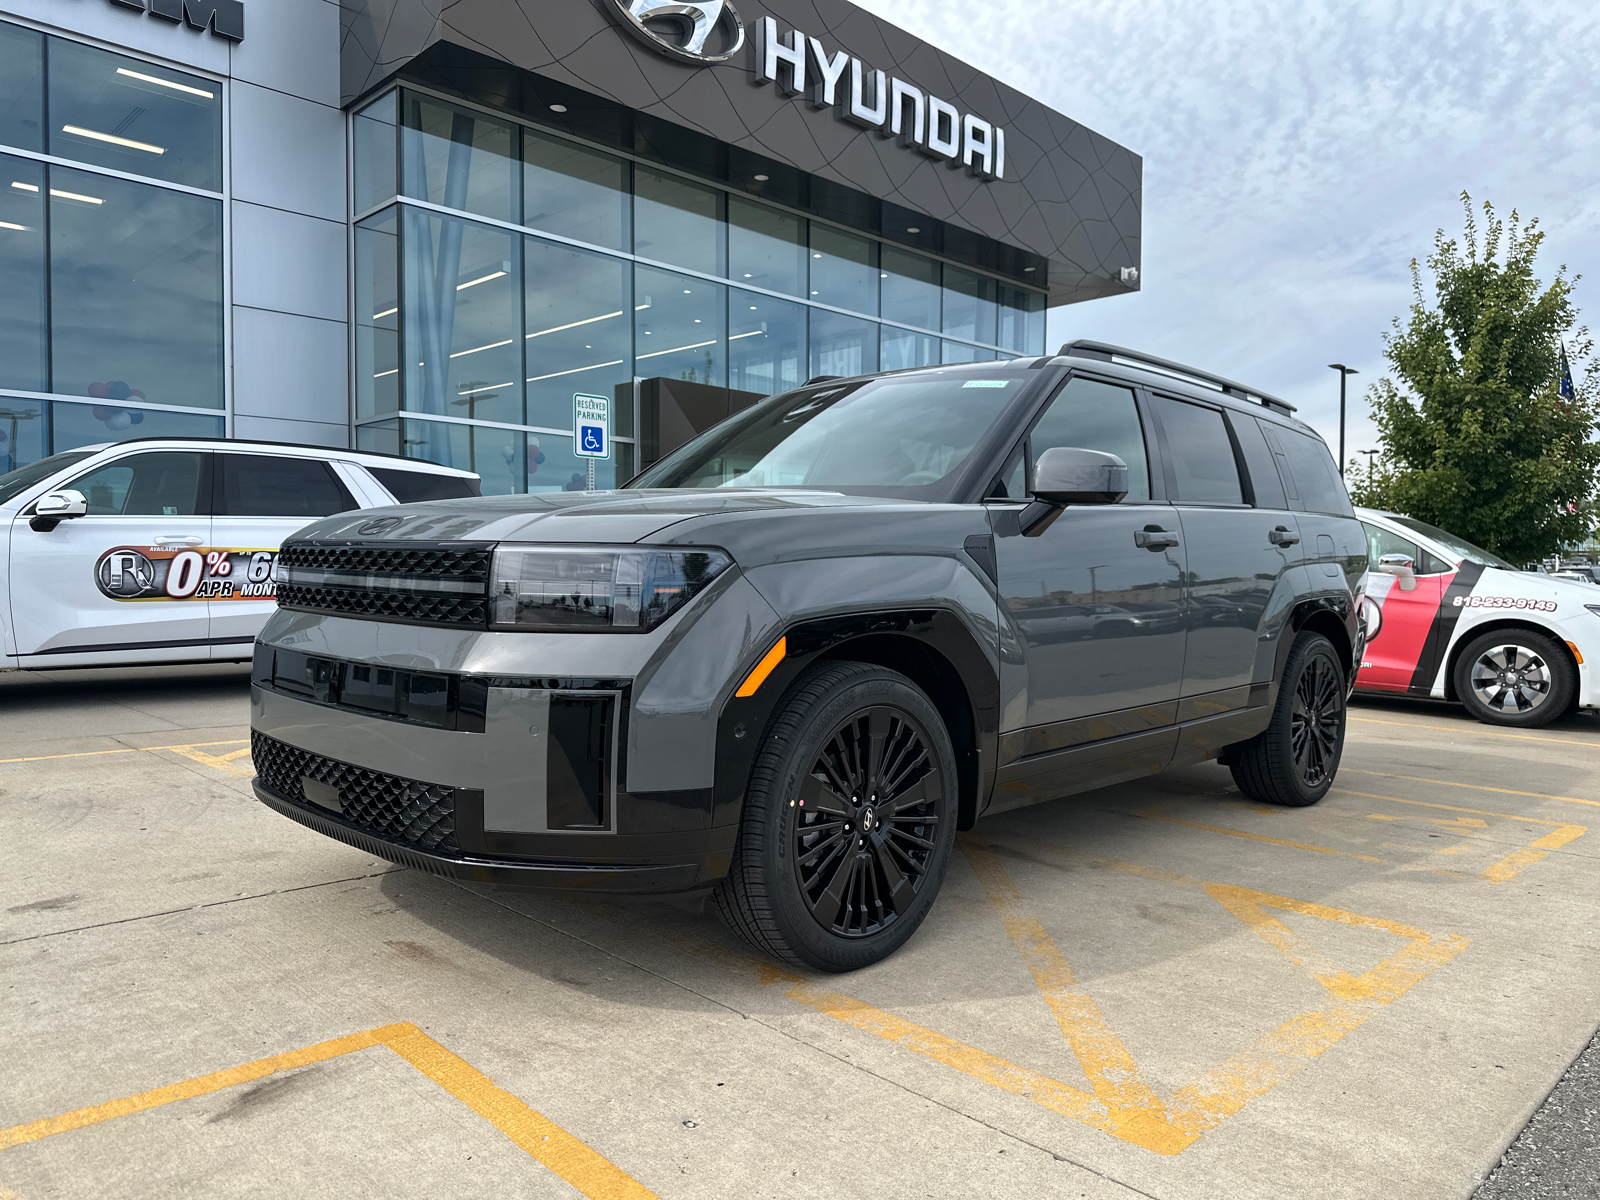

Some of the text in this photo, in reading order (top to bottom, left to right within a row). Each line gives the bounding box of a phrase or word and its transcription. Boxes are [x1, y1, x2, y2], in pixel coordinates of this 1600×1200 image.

[757, 15, 1005, 180] HYUNDAI
[577, 399, 606, 411] RESERVED
[577, 410, 607, 422] PARKING
[195, 580, 235, 598] APR
[1453, 595, 1557, 612] 816-233-9149
[778, 773, 796, 859] CRUGEN
